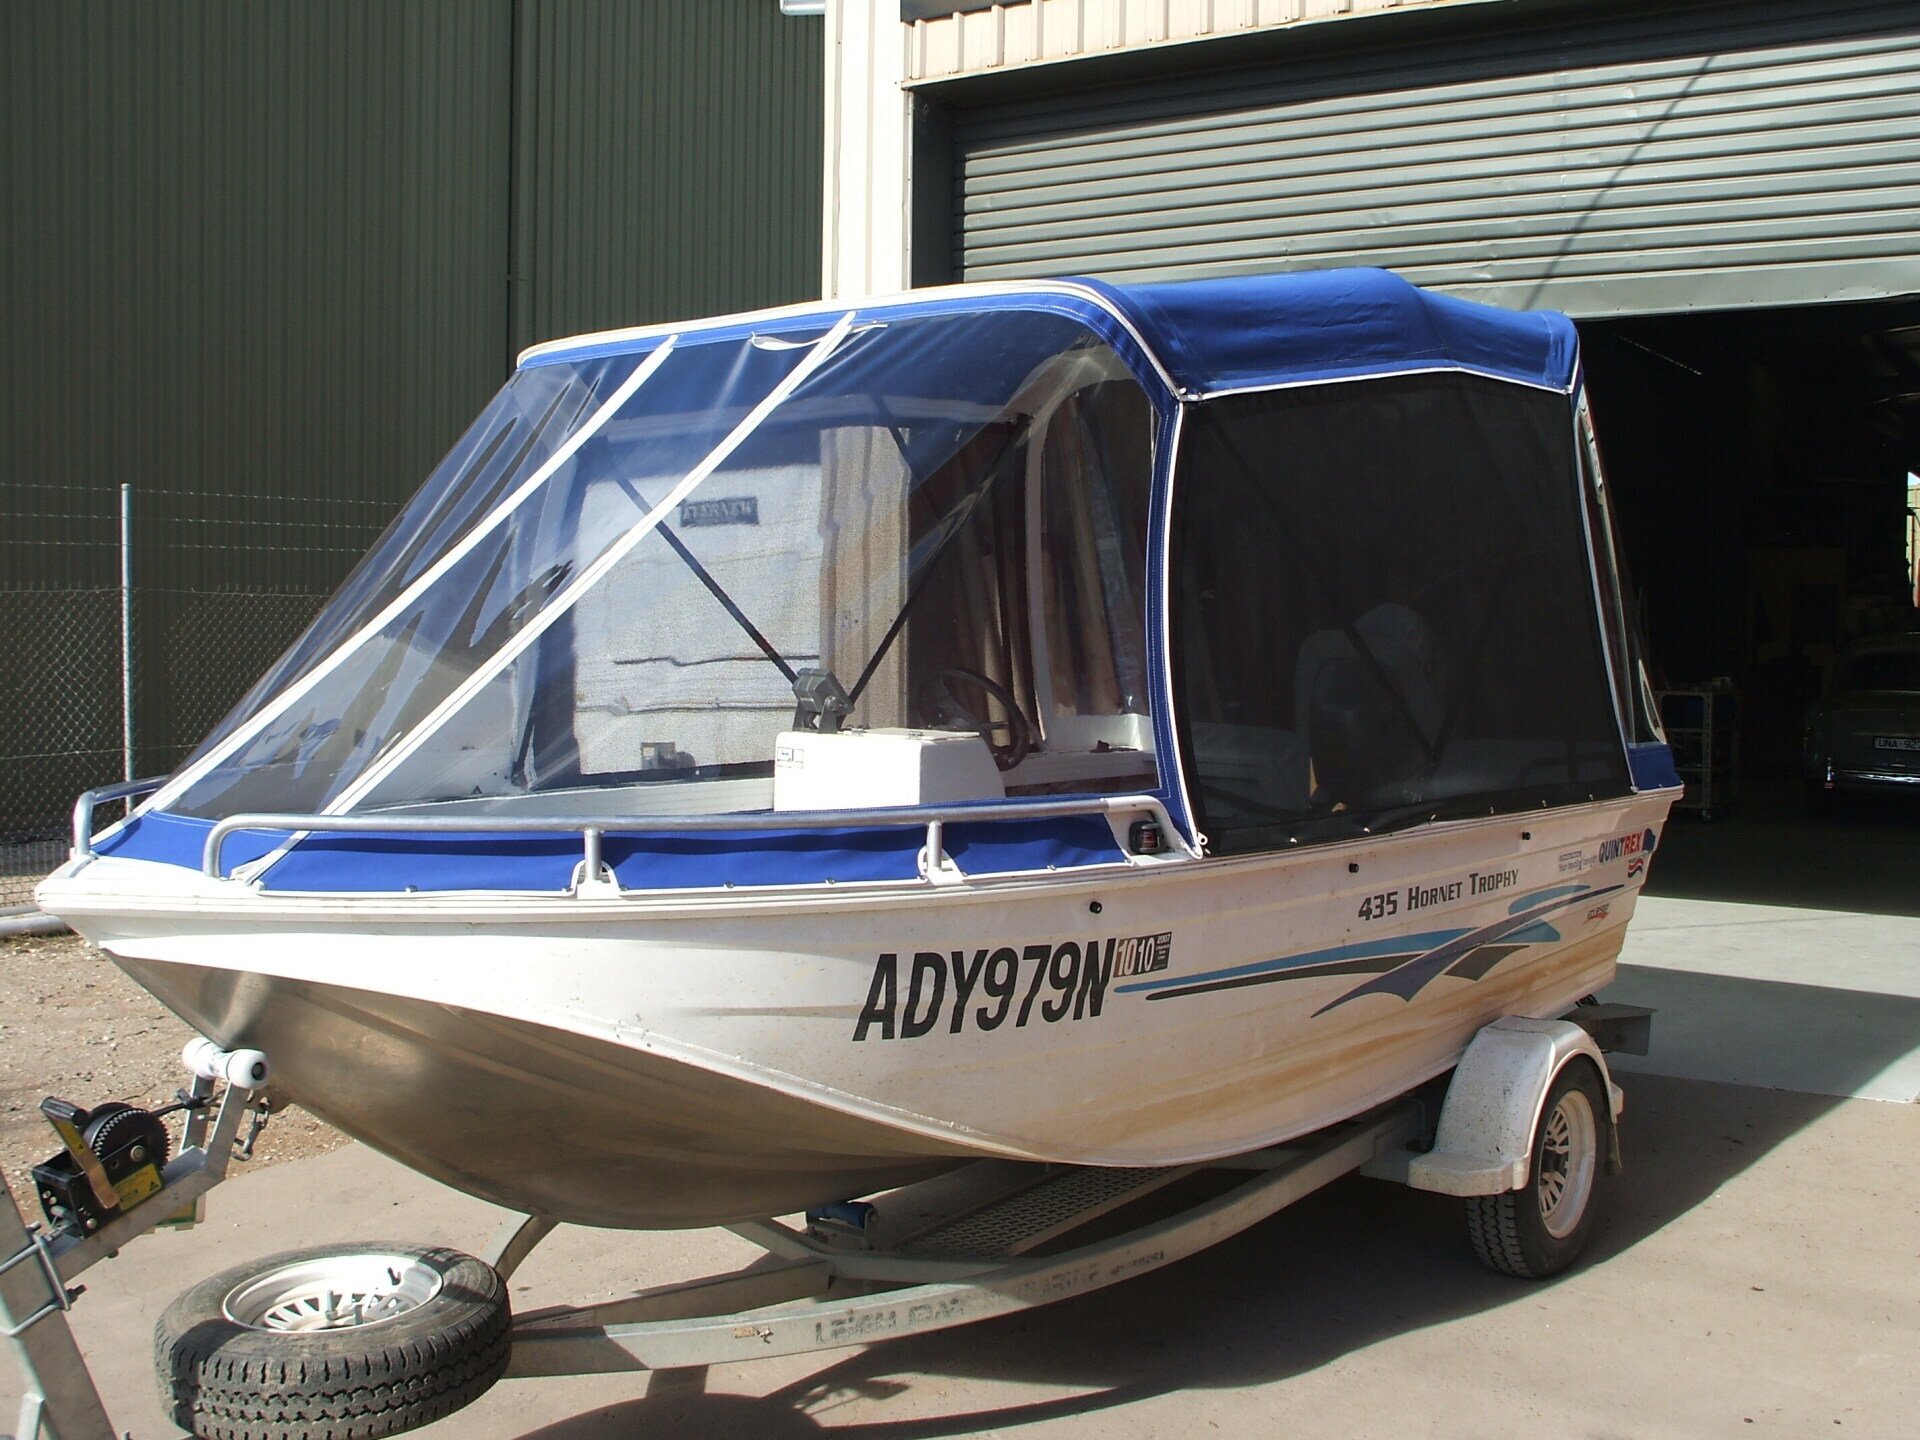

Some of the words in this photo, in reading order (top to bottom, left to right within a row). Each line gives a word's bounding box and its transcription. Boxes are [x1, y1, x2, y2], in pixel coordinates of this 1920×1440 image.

[1599, 832, 1643, 863] QUINTREX
[1358, 891, 1398, 921] 435
[1407, 880, 1463, 911] HORNET
[1469, 868, 1519, 896] TROPHY
[852, 938, 1117, 1041] ADY979N
